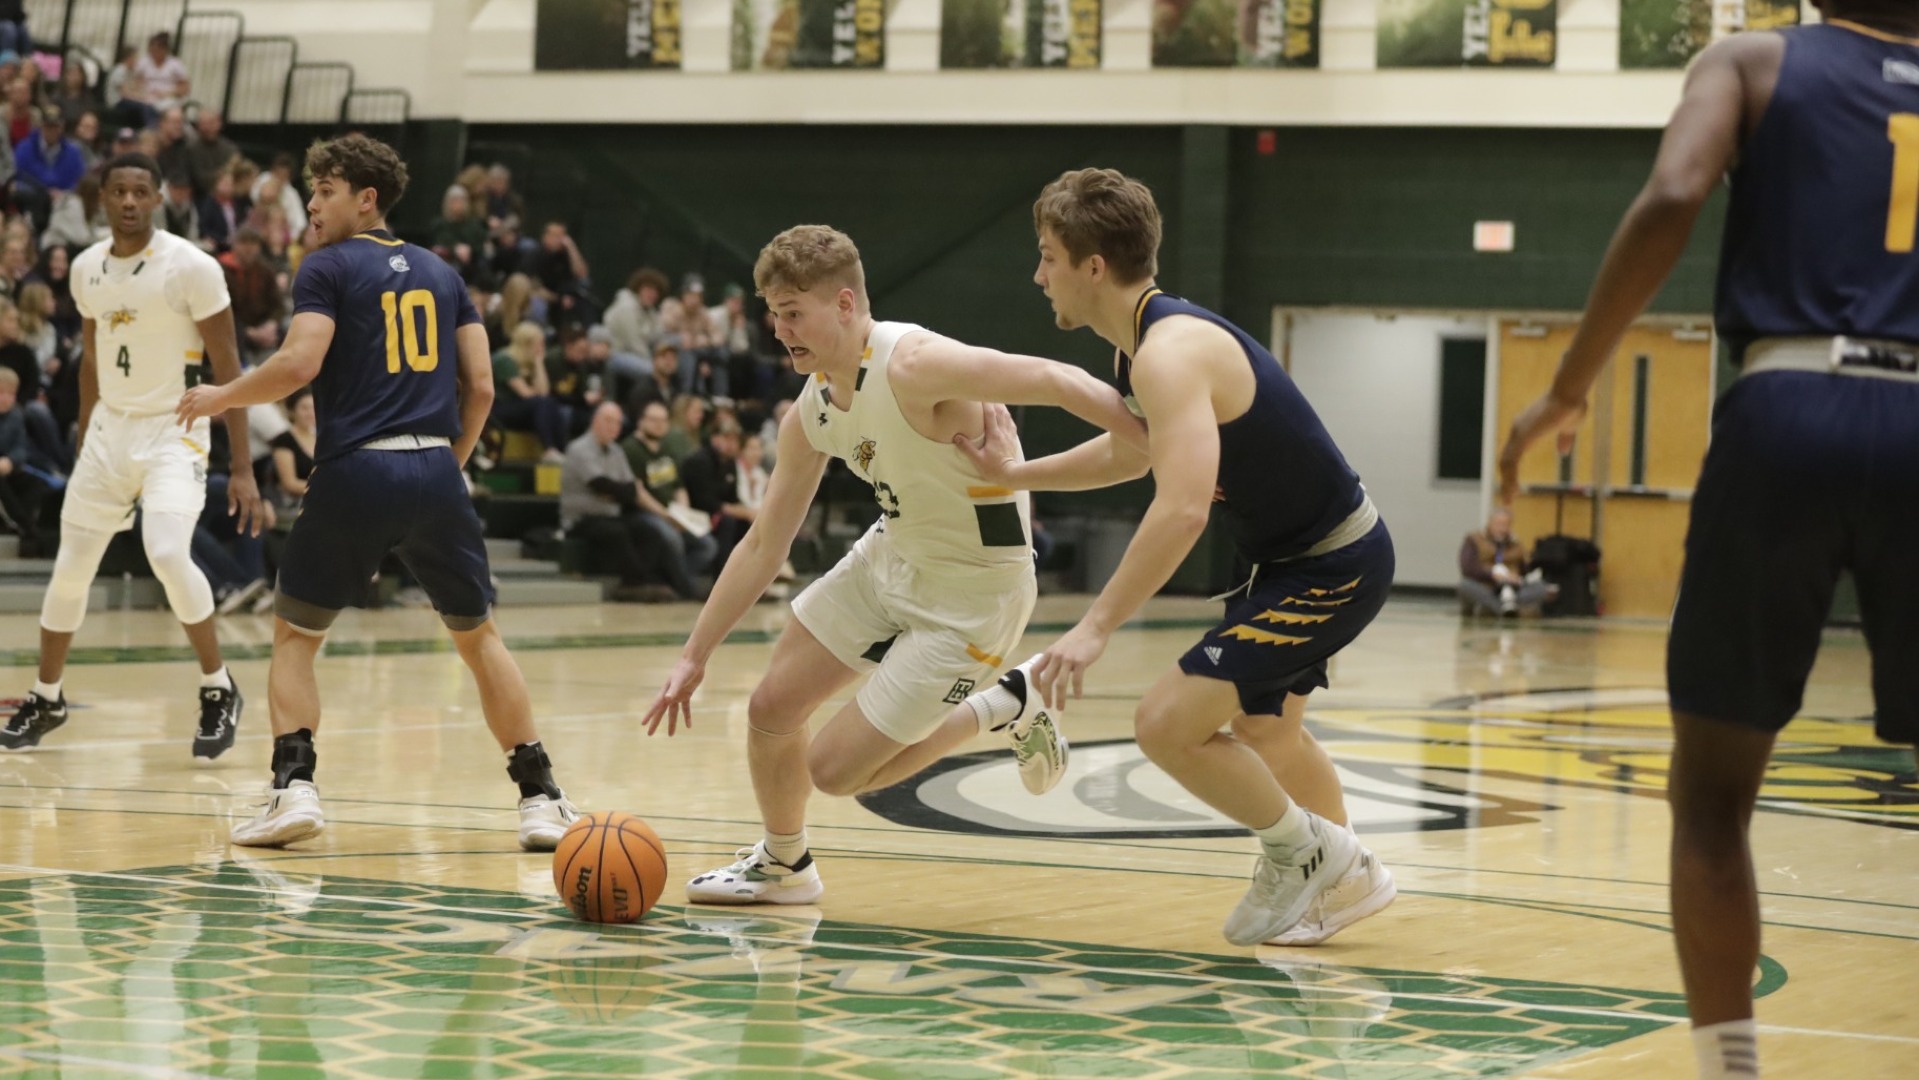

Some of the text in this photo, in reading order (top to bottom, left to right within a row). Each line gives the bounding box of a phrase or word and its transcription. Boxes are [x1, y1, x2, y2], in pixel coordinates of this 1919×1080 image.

[1284, 0, 1312, 57] WO
[381, 289, 438, 374] 10
[116, 345, 131, 377] 4
